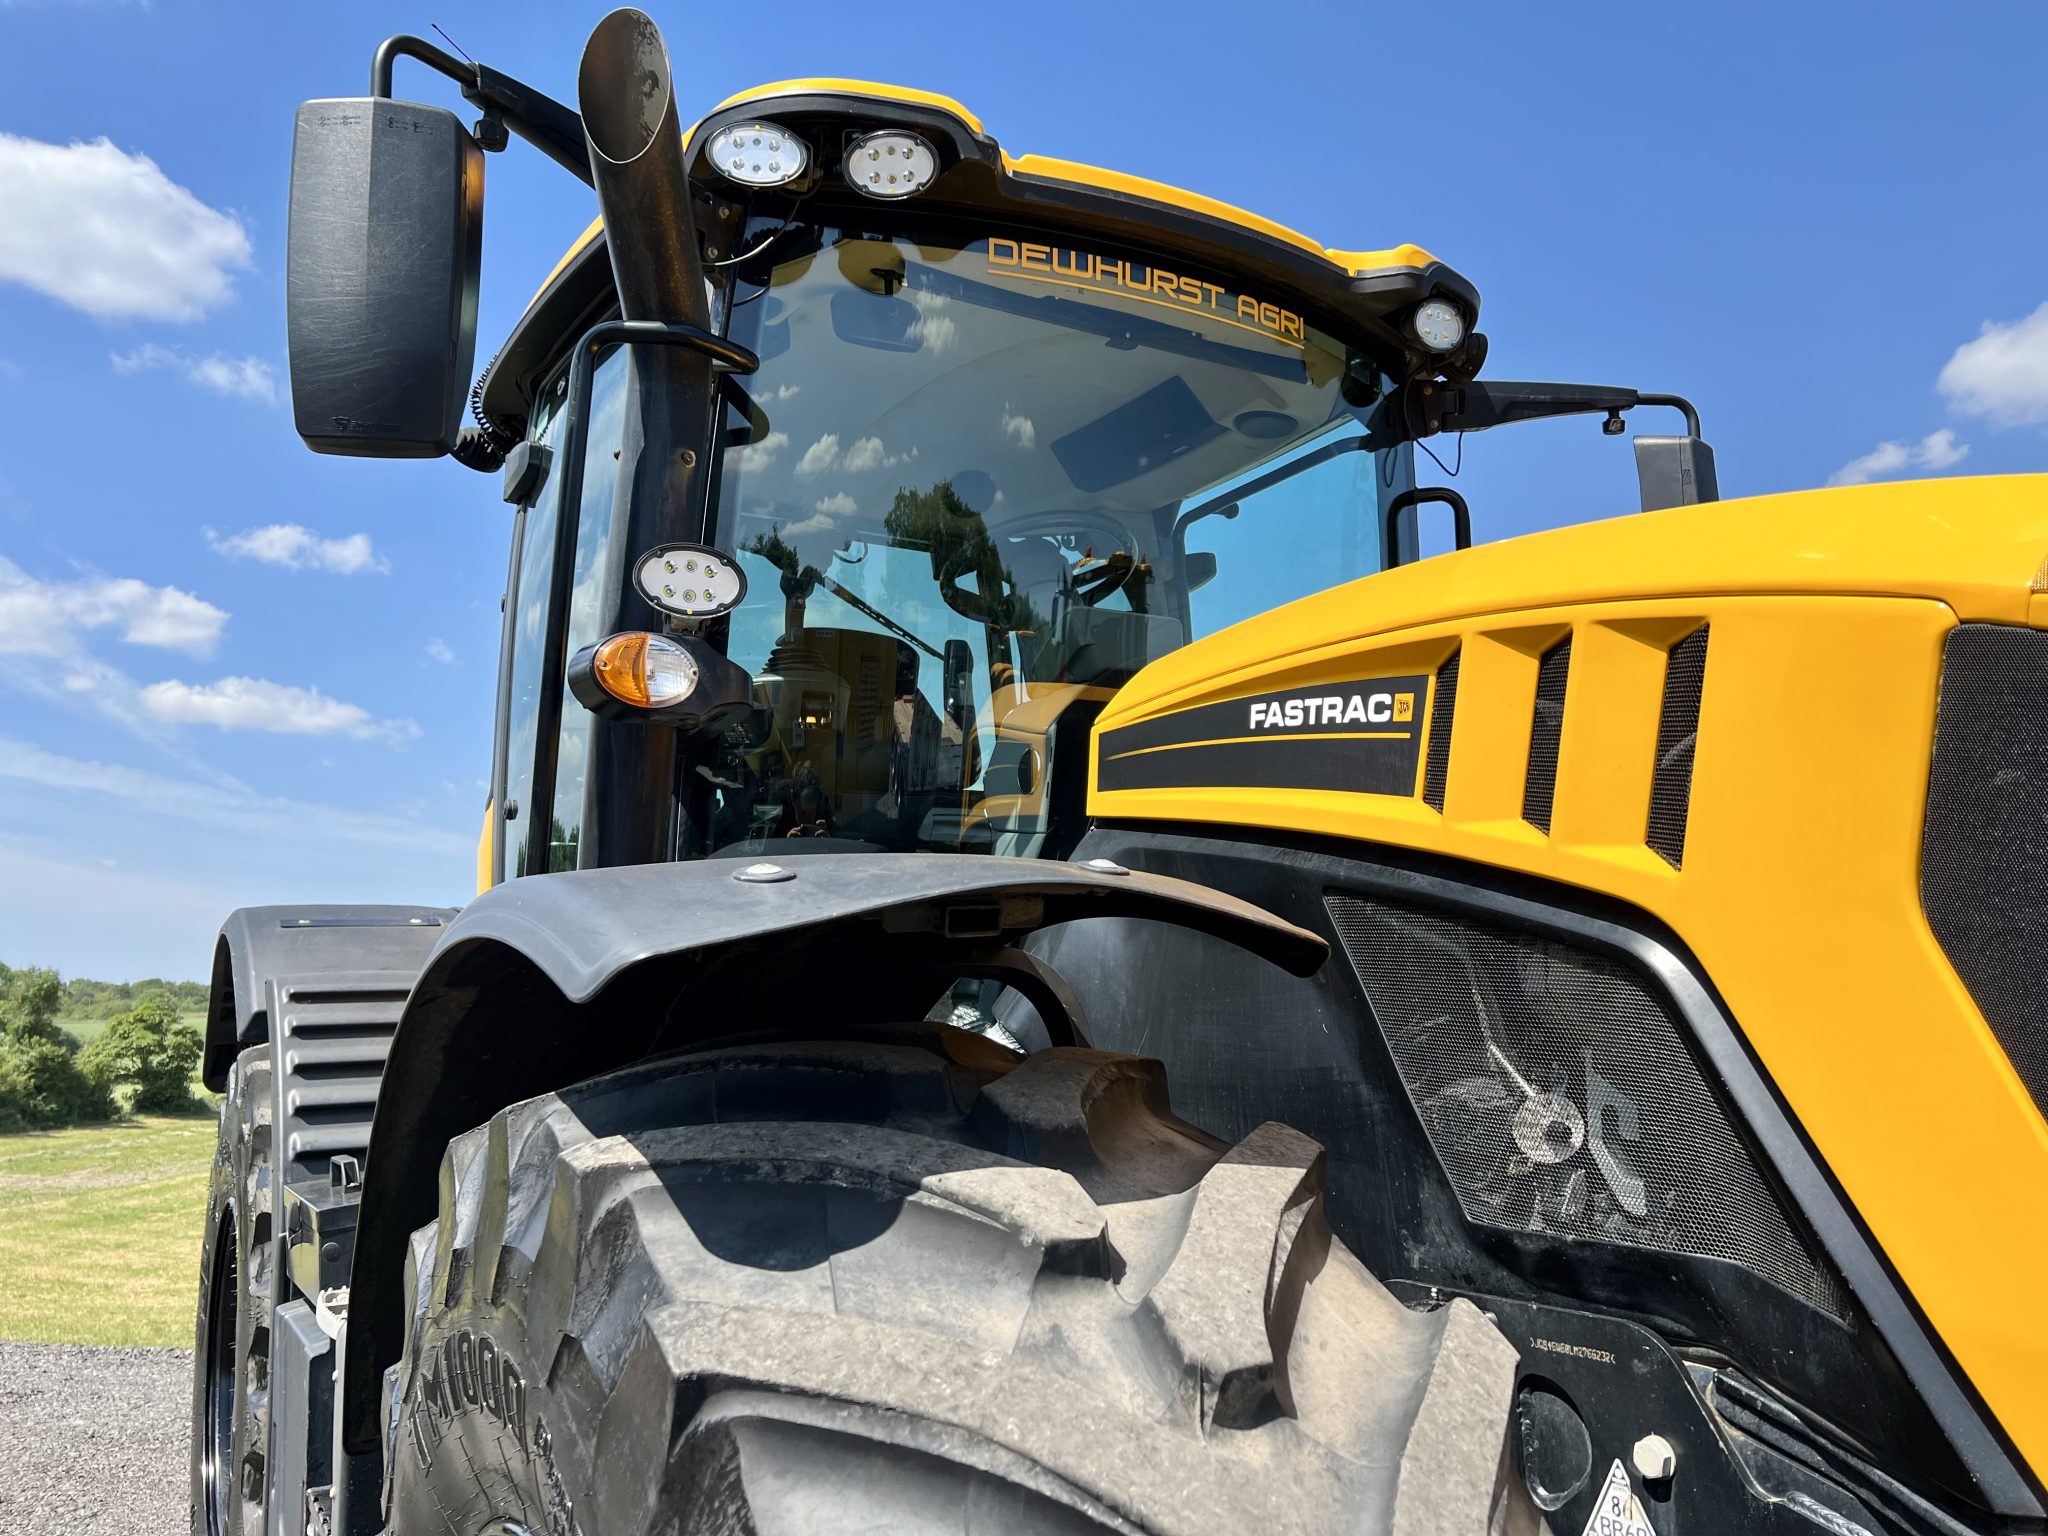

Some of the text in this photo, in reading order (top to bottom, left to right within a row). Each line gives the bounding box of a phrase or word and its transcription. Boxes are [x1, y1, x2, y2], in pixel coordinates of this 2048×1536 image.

[988, 237, 1305, 340] DEWHURST AGRI
[1249, 693, 1392, 730] FASTRAC
